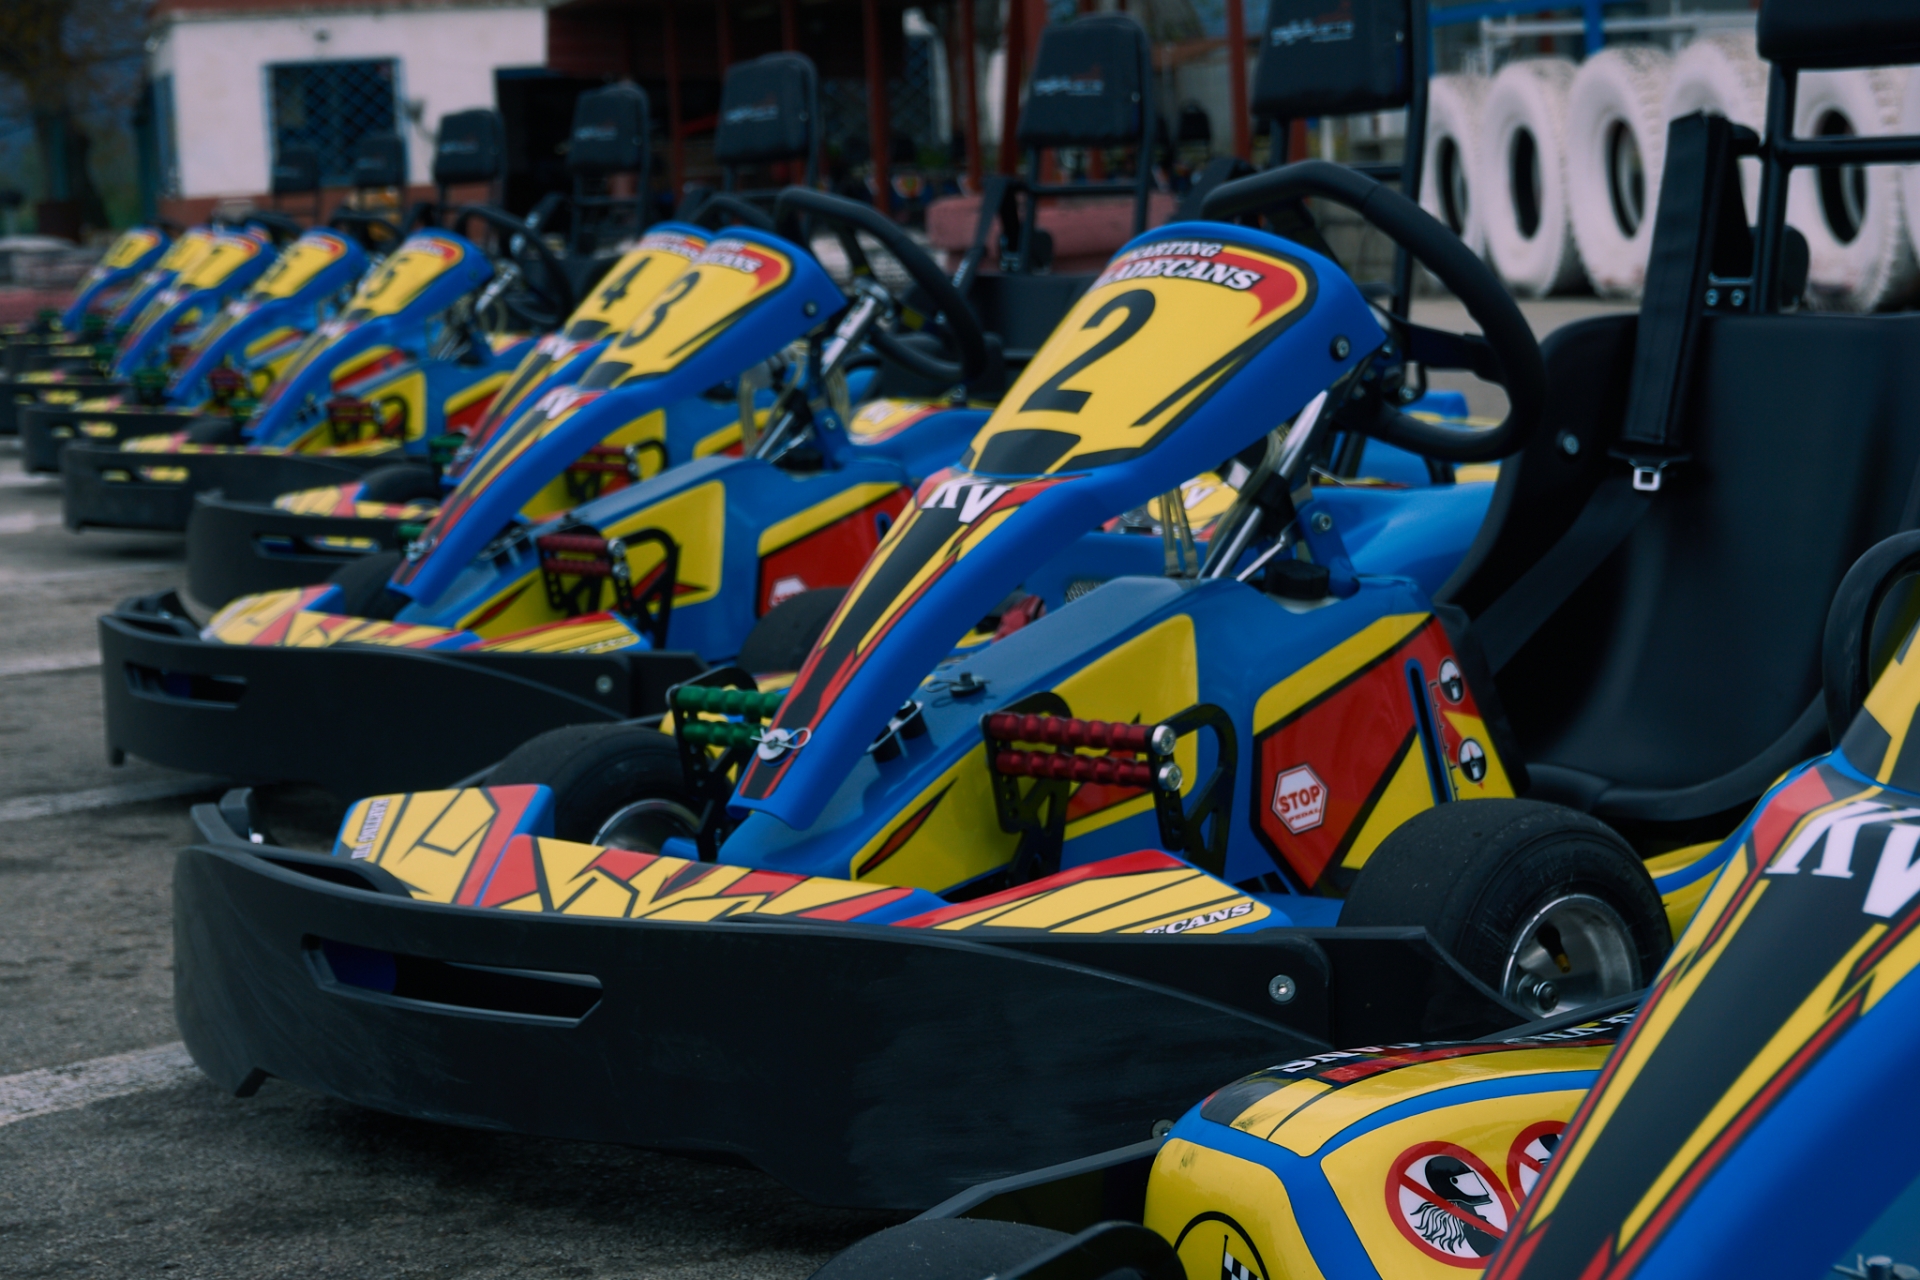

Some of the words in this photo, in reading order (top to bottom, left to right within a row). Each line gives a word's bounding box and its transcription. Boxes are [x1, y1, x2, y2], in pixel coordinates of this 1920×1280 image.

[600, 256, 652, 312] 4
[618, 271, 701, 349] 3
[1018, 289, 1156, 414] 2
[1279, 785, 1321, 814] STOP
[1288, 807, 1323, 824] PEDAL
